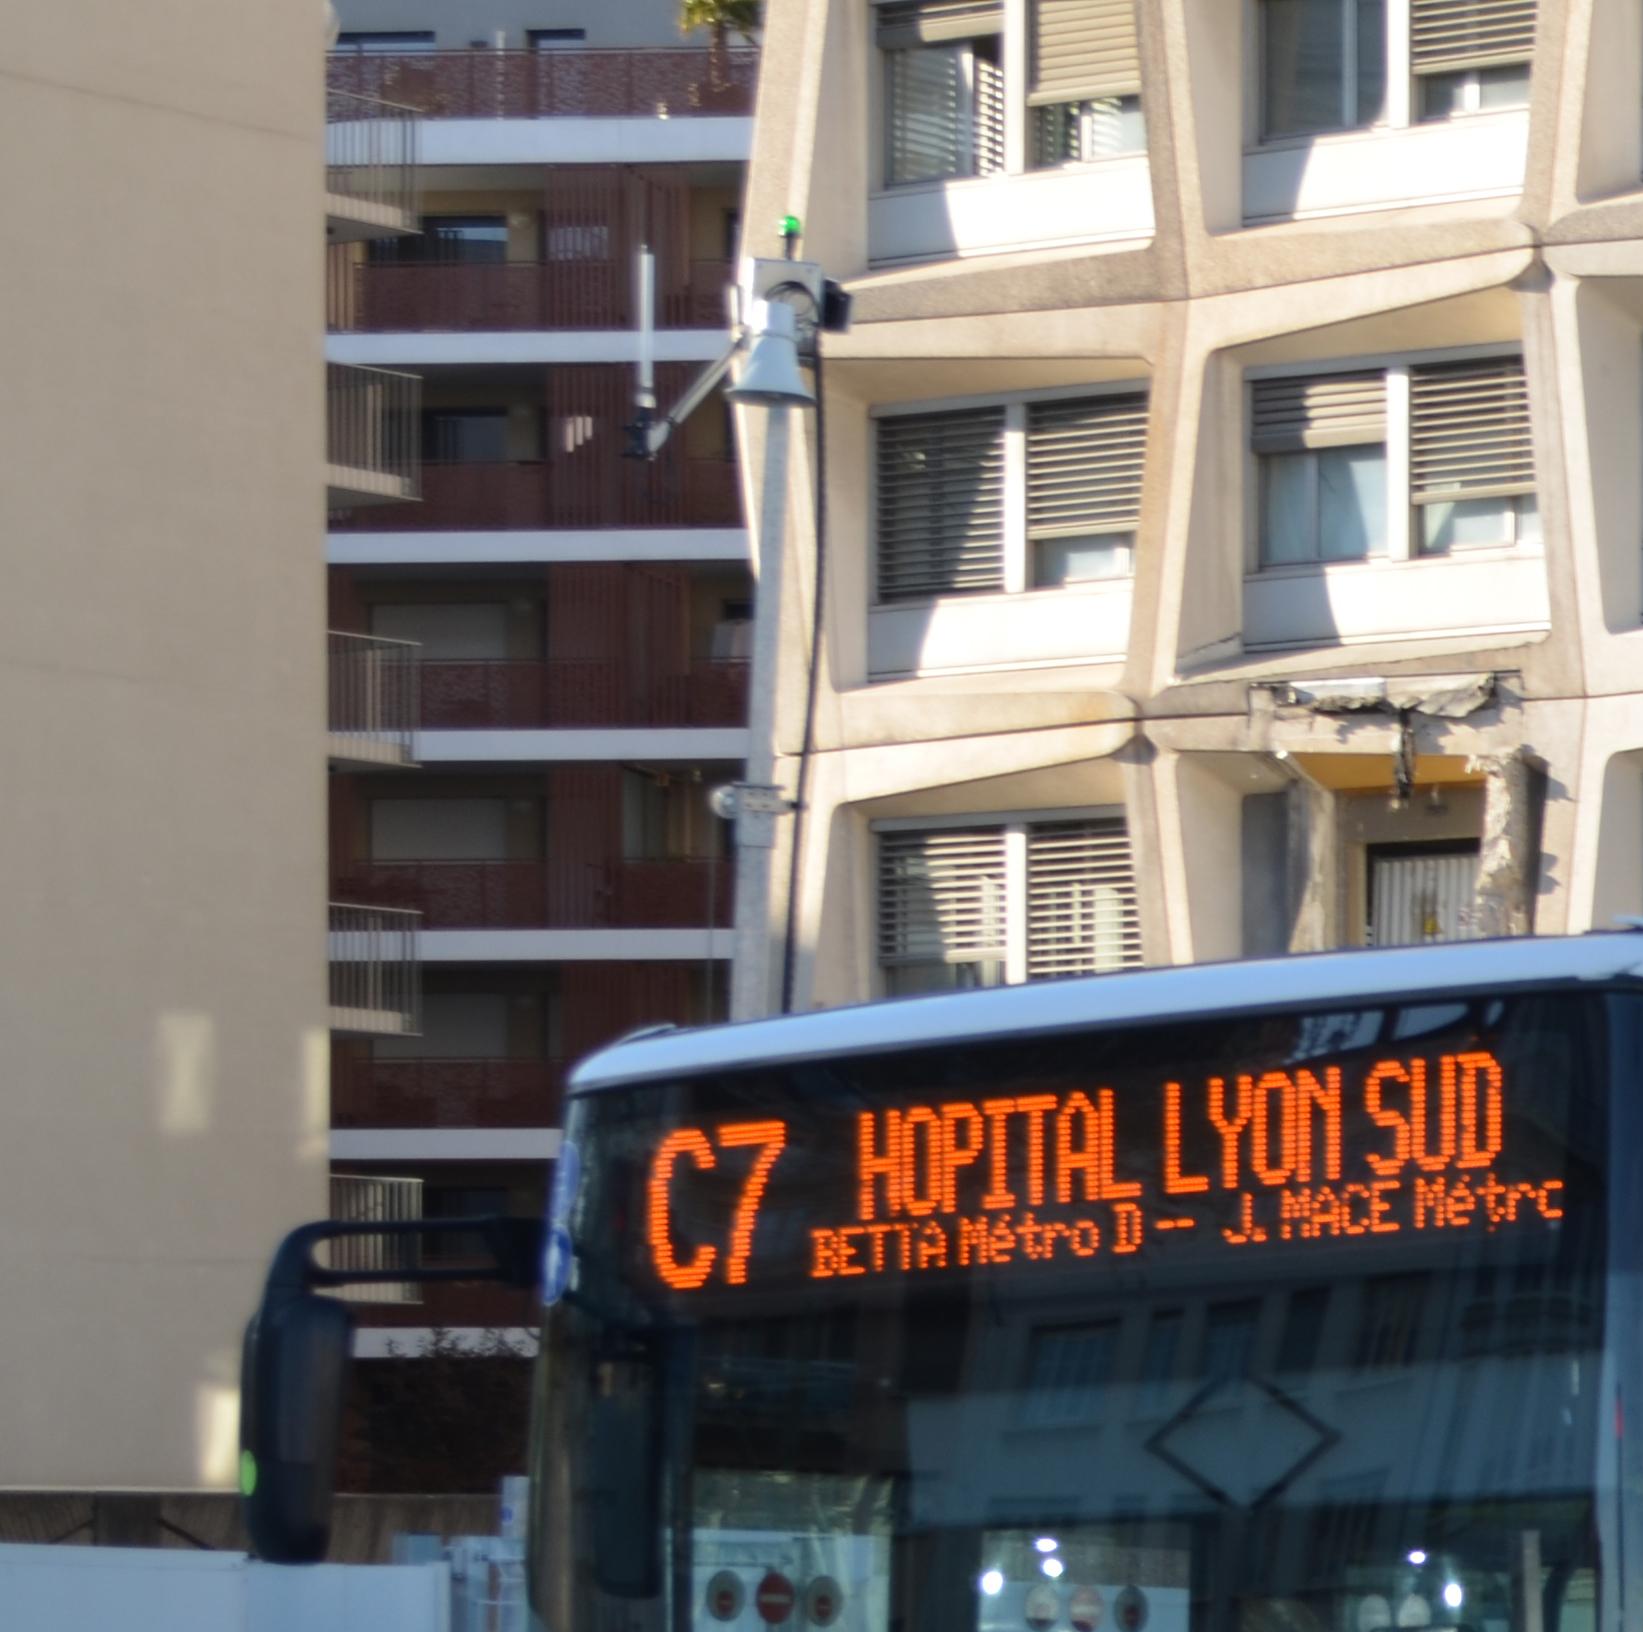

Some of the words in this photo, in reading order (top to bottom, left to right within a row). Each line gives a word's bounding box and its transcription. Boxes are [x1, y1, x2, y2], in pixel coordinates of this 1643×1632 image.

[647, 1120, 789, 1290] C7
[857, 1088, 1144, 1222] HOPITAL
[1163, 1066, 1341, 1195] LYON
[1365, 1051, 1503, 1176] SUD
[958, 1212, 1101, 1267] Métro
[1112, 1202, 1144, 1255] D
[1280, 1179, 1402, 1241] MACE
